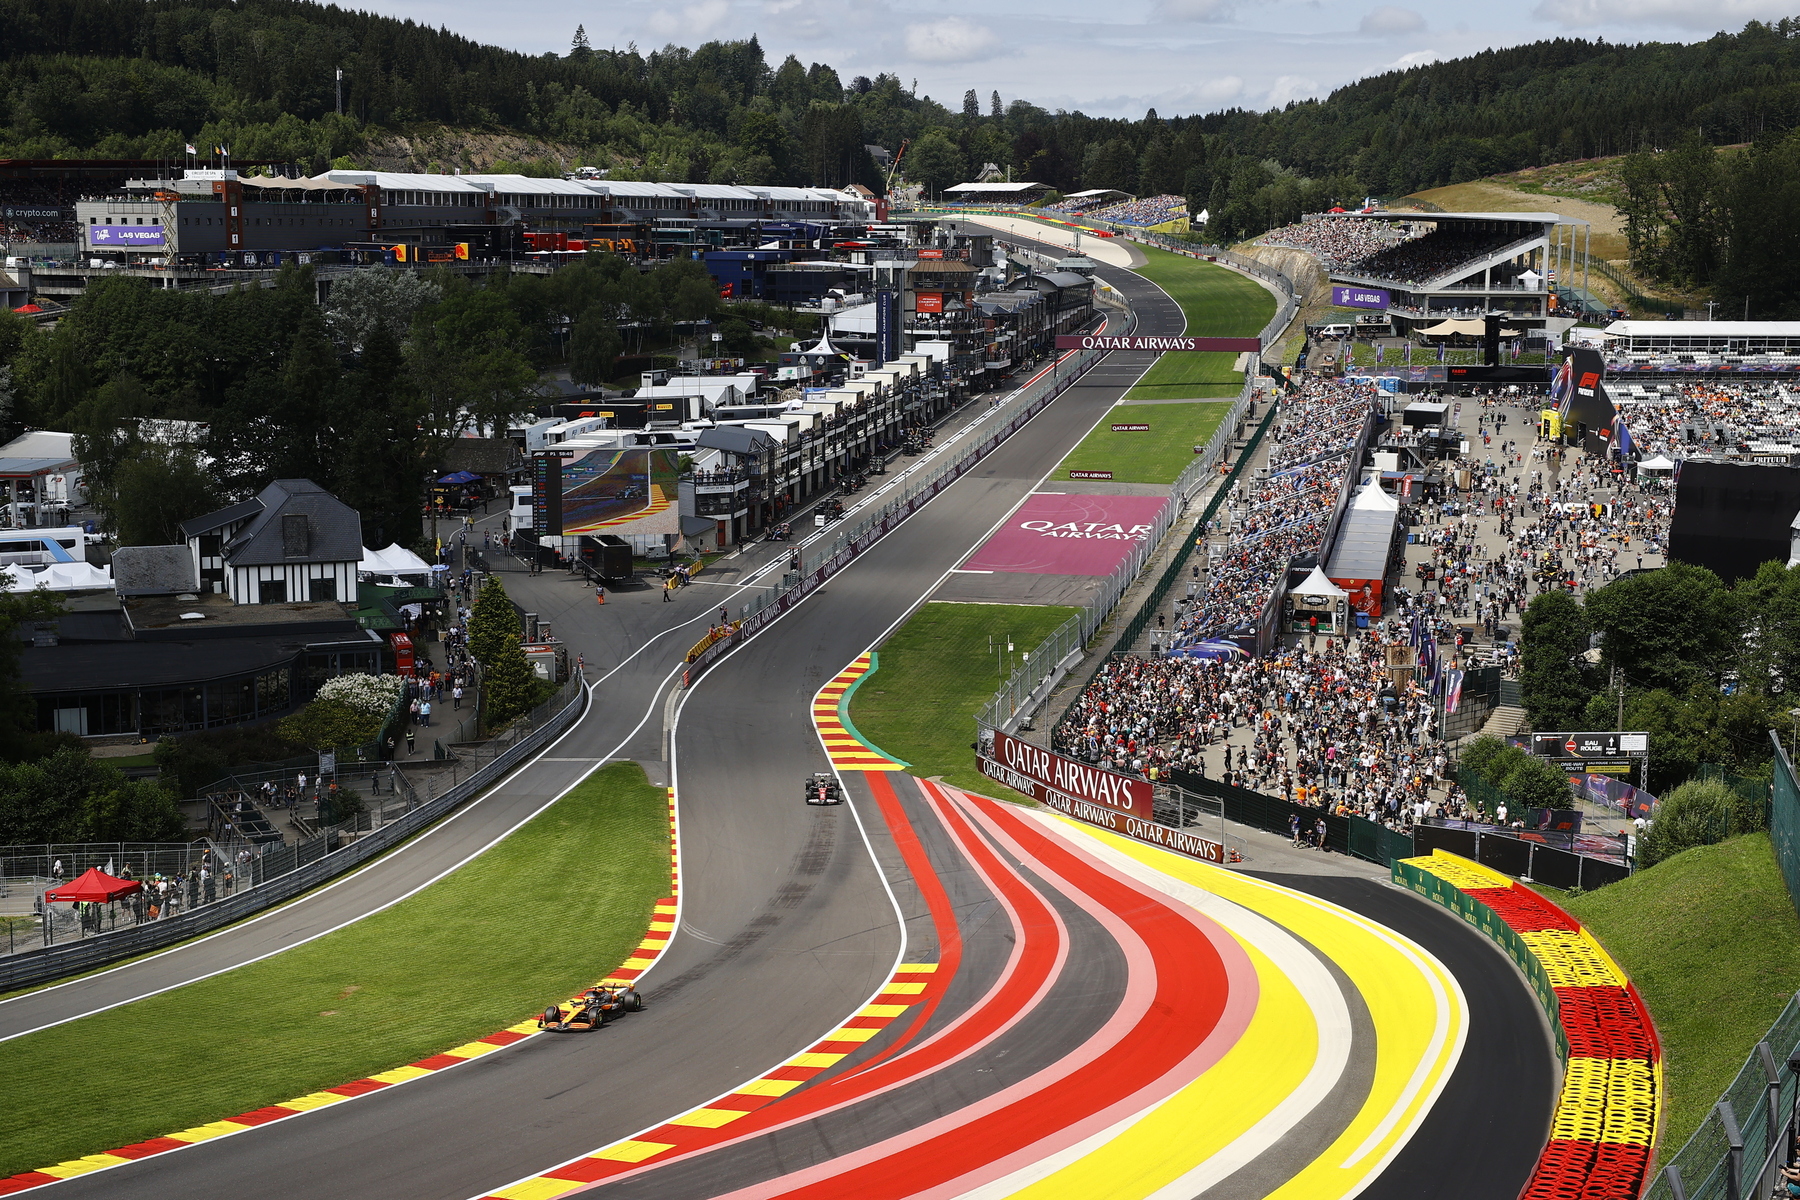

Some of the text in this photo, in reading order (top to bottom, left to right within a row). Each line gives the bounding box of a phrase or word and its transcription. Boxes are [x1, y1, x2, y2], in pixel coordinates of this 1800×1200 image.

[244, 254, 256, 264] FIA
[299, 254, 311, 264] FIA
[1364, 294, 1380, 303] VEGAS
[1082, 337, 1195, 350] QATAR AIRWAYS
[1020, 521, 1153, 540] QATAR AIRWAYS
[857, 534, 869, 552] QATAR
[824, 547, 853, 578] QATAR AIRWAYS
[787, 572, 819, 606] QATAR AIRWAYS
[745, 601, 781, 636] QATAR AIRWAYS
[706, 636, 732, 663] QATAR AIRWAYS
[983, 760, 1035, 796] QATAR AIRWAYS
[1005, 738, 1133, 810] QATAR AIRWAYS
[1046, 790, 1116, 828] QATAR AIRWAYS
[1126, 818, 1216, 860] QATAR AIRWAYS
[1395, 875, 1408, 887] ROLEX
[1414, 884, 1426, 896] ROLEX
[1433, 893, 1444, 905] ROLEX
[1465, 913, 1477, 925] ROLEX
